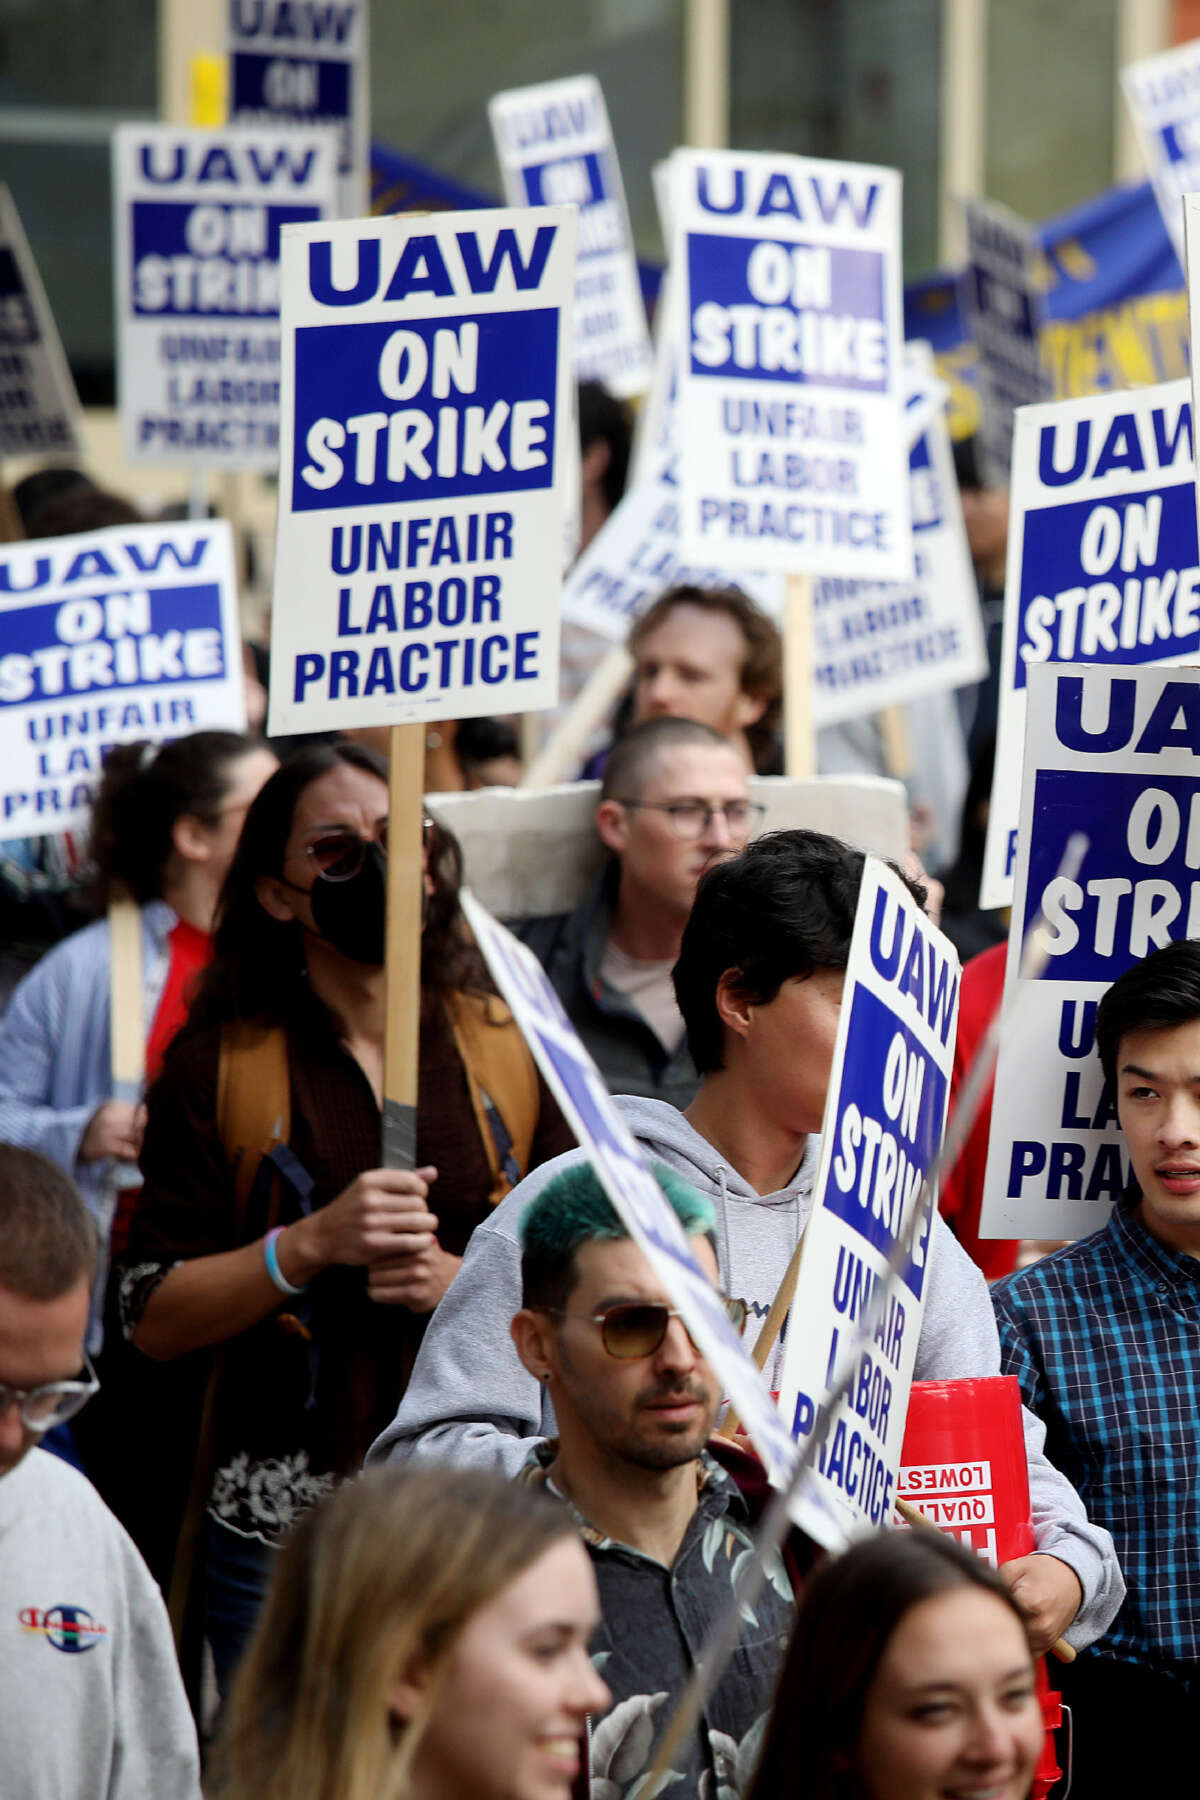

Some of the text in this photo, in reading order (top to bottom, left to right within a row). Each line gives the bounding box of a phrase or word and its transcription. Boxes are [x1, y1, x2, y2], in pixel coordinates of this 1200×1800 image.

[140, 145, 317, 185] UAW
[695, 166, 879, 229] UAW
[185, 205, 268, 256] ON
[135, 253, 280, 312] STRIK
[308, 226, 559, 307] UAW
[748, 242, 832, 309] ON
[378, 322, 479, 401] ON
[691, 302, 887, 381] STRIKE
[302, 400, 549, 490] STRIKE
[723, 397, 864, 446] UNFAIR
[732, 450, 857, 496] LABOR
[330, 511, 514, 575] UNFAIR
[700, 498, 890, 551] PRACTICE
[1080, 494, 1163, 576] ON
[0, 539, 209, 592] UAW
[55, 591, 152, 643] ON
[338, 575, 502, 637] LABOR
[0, 627, 222, 702] STRIKE
[293, 631, 540, 703] PRACTICE
[29, 697, 195, 742] UNFAIR
[870, 885, 957, 1048] UAW
[883, 1031, 925, 1144] ON
[834, 1102, 931, 1268] STRIKE
